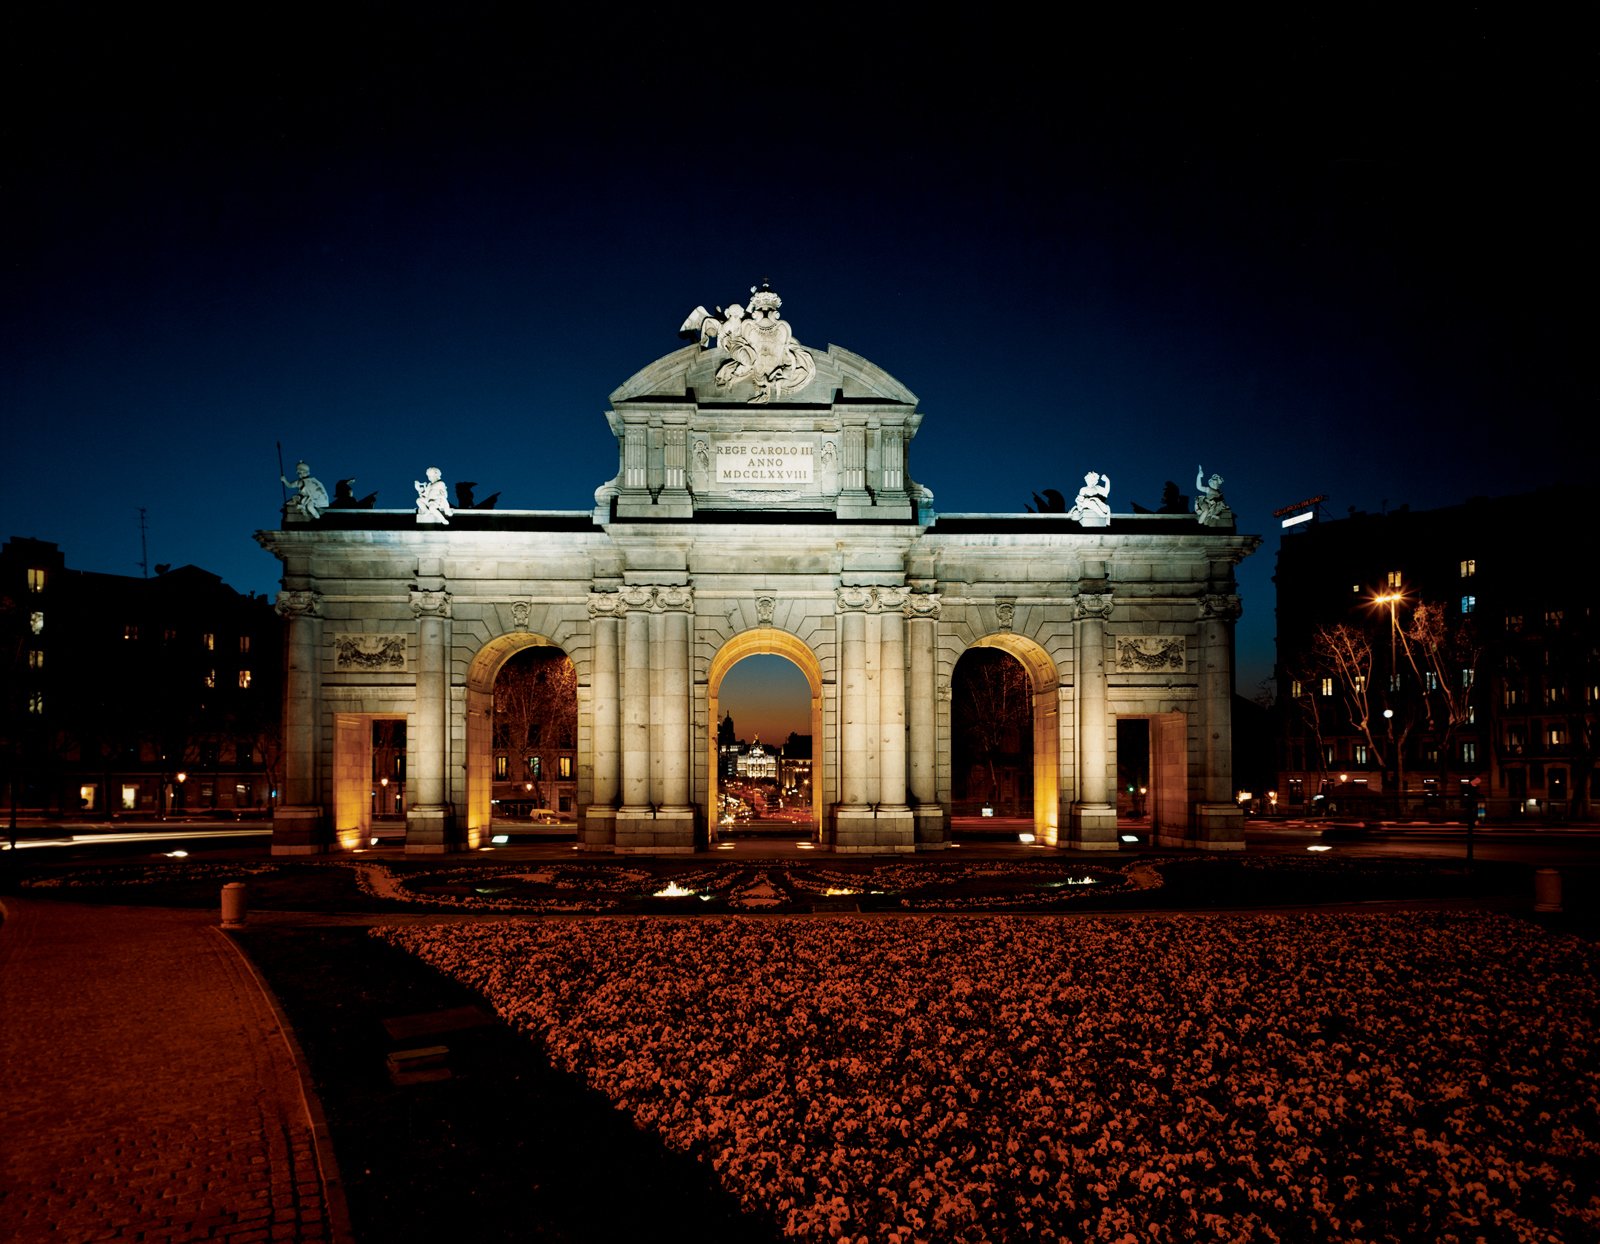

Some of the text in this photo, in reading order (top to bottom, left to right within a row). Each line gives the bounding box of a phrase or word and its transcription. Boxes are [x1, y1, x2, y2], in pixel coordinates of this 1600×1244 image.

[716, 446, 813, 455] REGE CAROLO III
[747, 458, 783, 467] ANNO
[723, 470, 807, 479] MDCCLXXVIII
